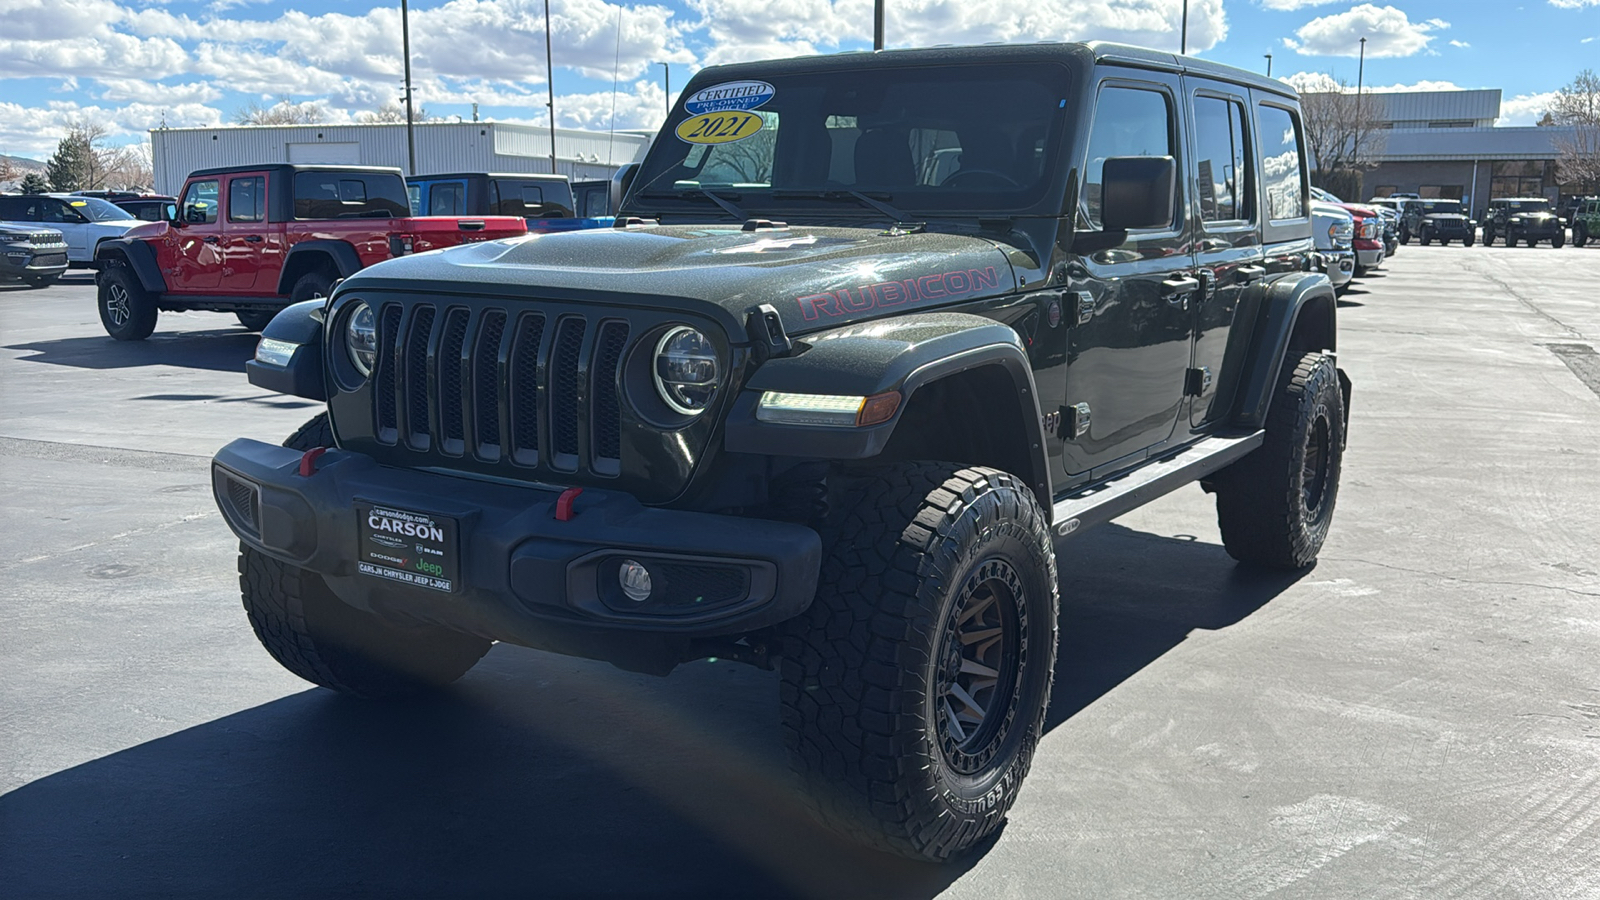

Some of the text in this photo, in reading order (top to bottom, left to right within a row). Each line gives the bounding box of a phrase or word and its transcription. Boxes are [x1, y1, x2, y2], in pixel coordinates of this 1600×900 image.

[697, 84, 766, 102] CERTIFIED
[696, 96, 760, 109] PRE-OWNED
[687, 116, 752, 138] 2021
[797, 266, 999, 321] RUBICON
[376, 509, 429, 524] carsondodge.com
[368, 516, 444, 542] CARSON
[373, 533, 402, 543] CHRYSLER
[370, 552, 402, 564] DODGE
[424, 547, 443, 556] RAM
[416, 558, 442, 576] Jeep
[383, 569, 413, 581] CHRYSLER
[414, 576, 429, 585] JEEP
